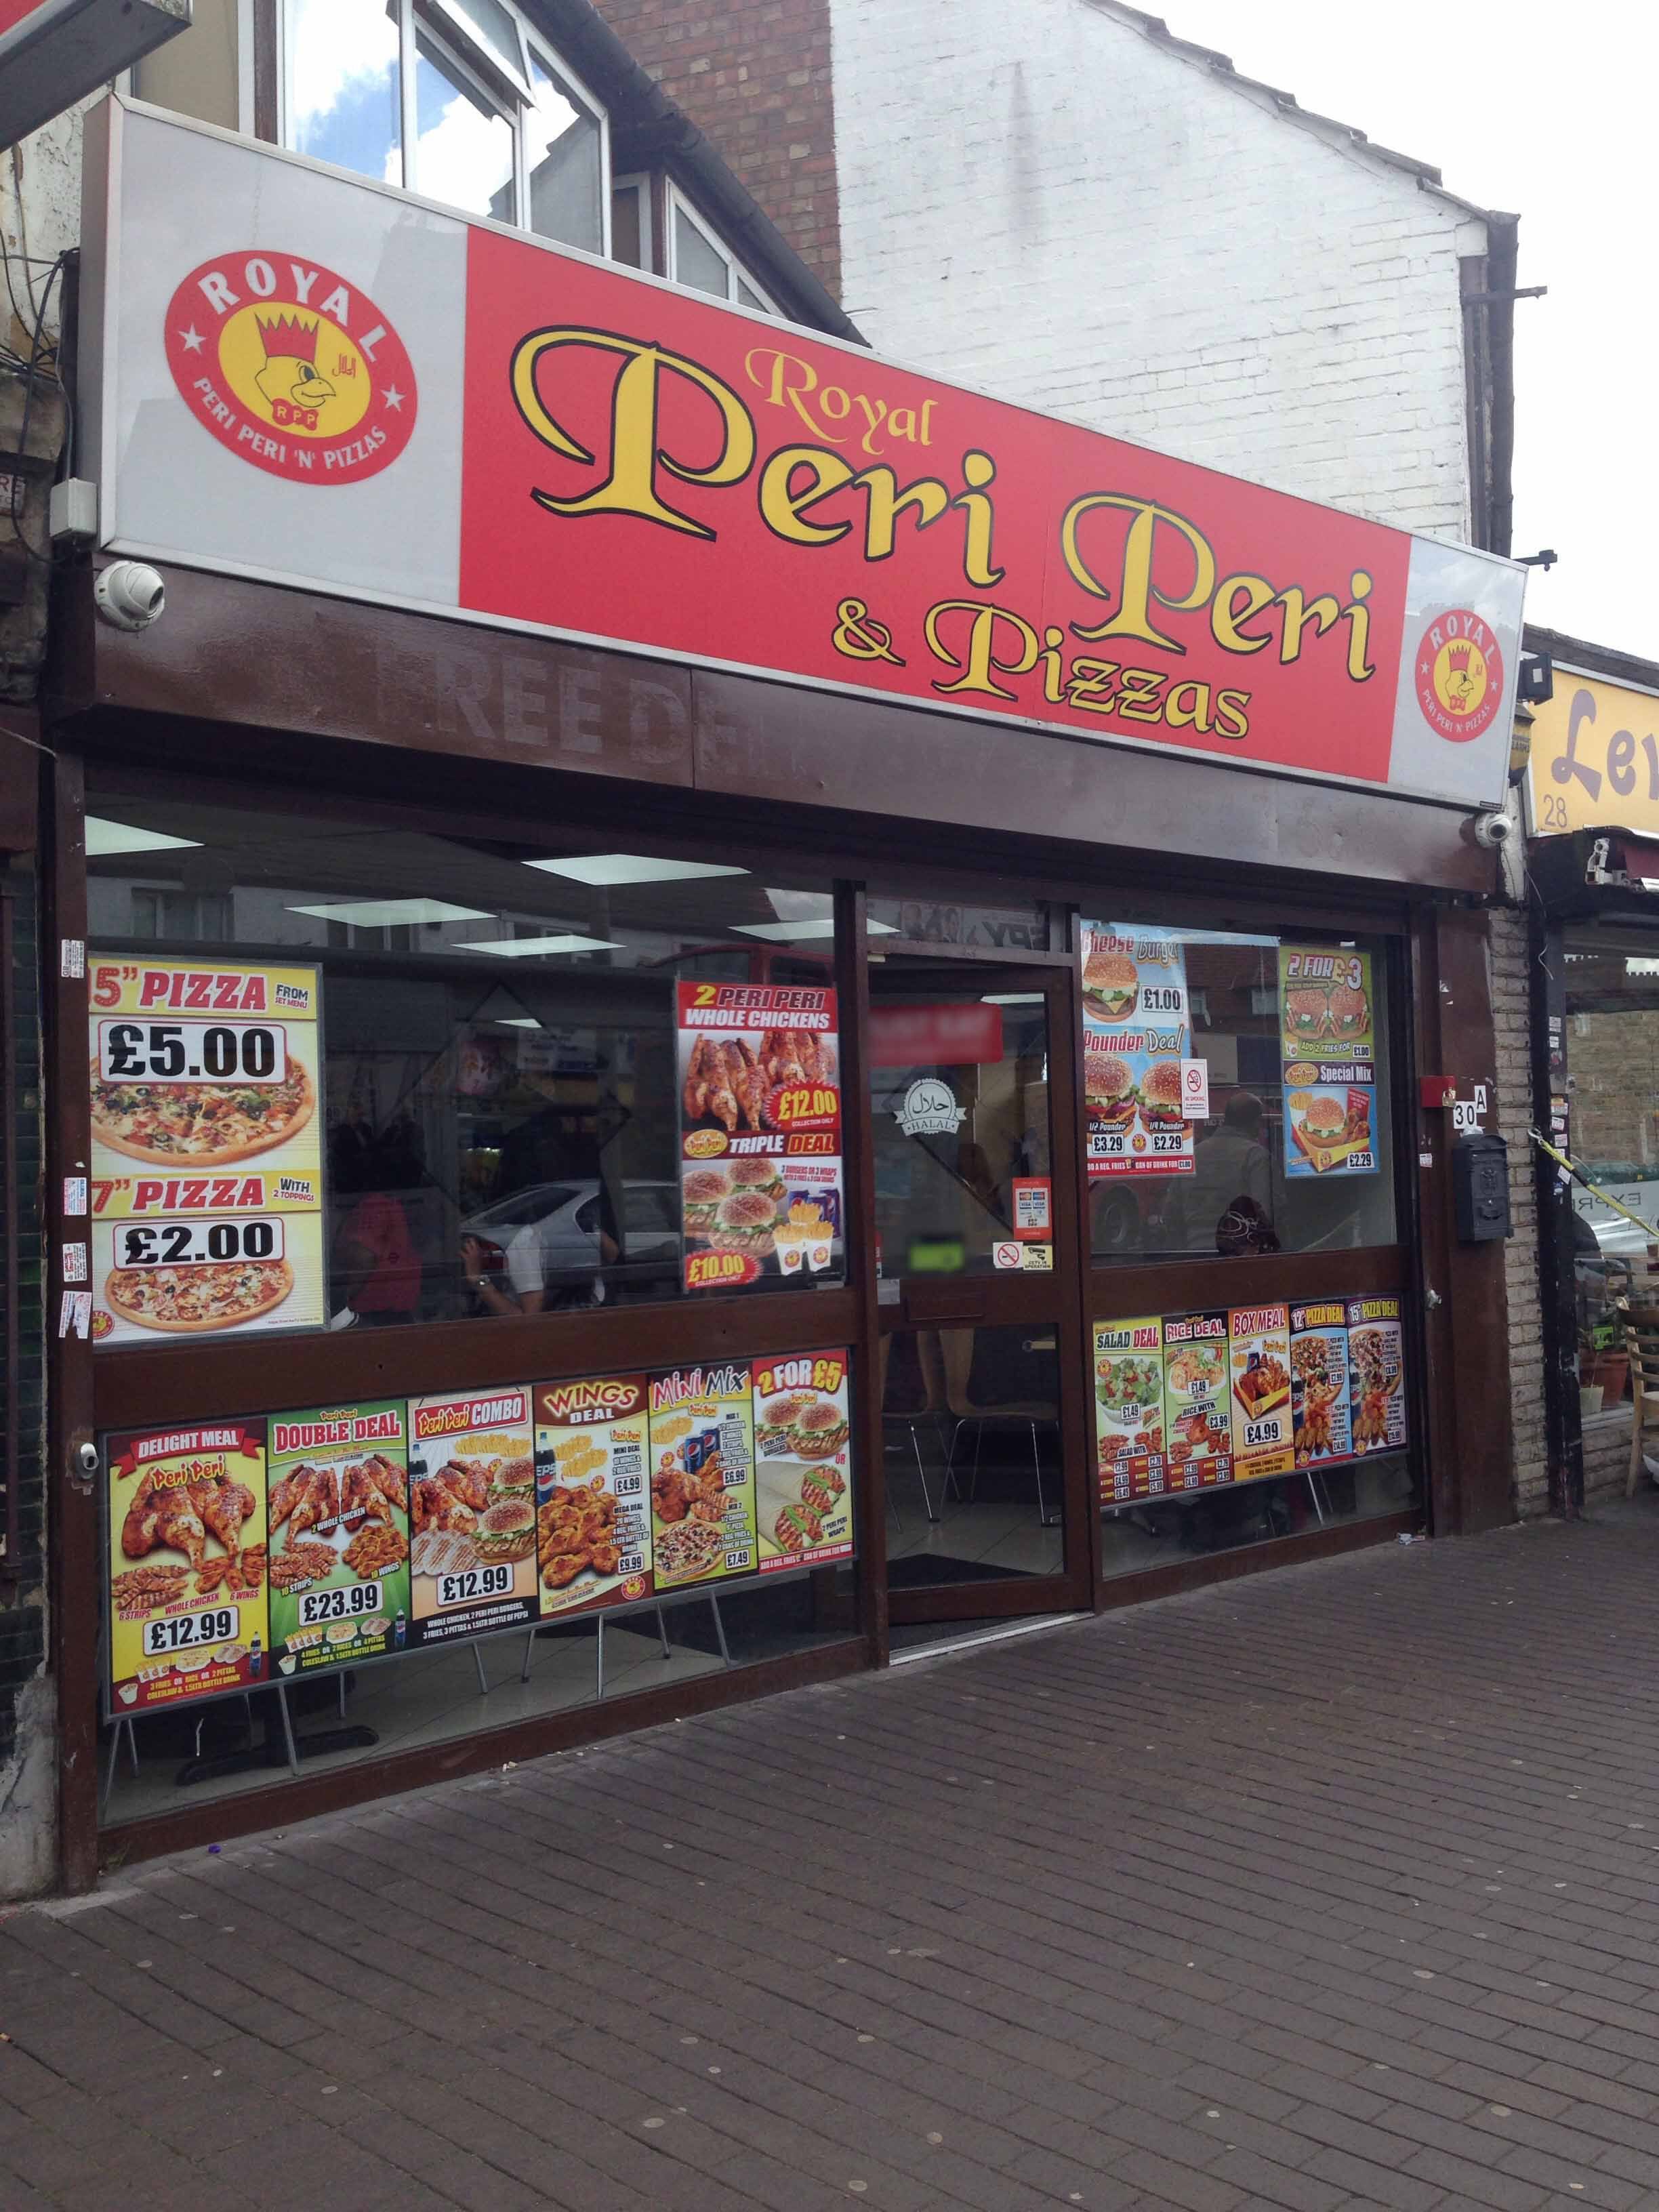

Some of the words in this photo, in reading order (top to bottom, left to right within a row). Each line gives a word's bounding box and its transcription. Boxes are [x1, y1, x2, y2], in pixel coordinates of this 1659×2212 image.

[197, 258, 386, 362] ROYAL
[745, 347, 938, 455] Royal
[193, 377, 233, 430] PERI
[237, 425, 286, 464] PERI
[324, 426, 387, 470] PIZZAS
[509, 324, 1006, 588] Peri
[1059, 491, 1376, 682] Peri
[1430, 615, 1495, 664] ROYAL
[831, 596, 906, 668] &
[924, 598, 1252, 739] Pizzas
[1423, 689, 1437, 716] PERI
[1437, 715, 1453, 733] PERI
[1466, 705, 1490, 731] PIZZAS
[1544, 794, 1567, 827] 28
[1288, 953, 1300, 976] 2
[1303, 954, 1334, 977] FOR
[140, 971, 267, 1010] PIZZA
[276, 983, 308, 1002] FROM
[693, 985, 716, 1006] 2
[717, 987, 772, 1008] PERI
[773, 989, 825, 1010] PERI
[1144, 988, 1181, 1010] £1.00
[274, 996, 287, 1006] SET
[287, 998, 308, 1008] MENU
[685, 1008, 745, 1027] WHOLE
[747, 1011, 830, 1029] CHICKENS
[1084, 1029, 1145, 1052] Pounder
[1147, 1023, 1184, 1052] Deal
[1301, 1041, 1313, 1051] ADD
[1321, 1044, 1338, 1052] FRIES
[108, 1024, 275, 1078] £5.00
[1353, 1046, 1369, 1056] £1.00
[1320, 1065, 1354, 1082] Special
[1355, 1066, 1372, 1082] Mix
[778, 1090, 837, 1120] £12.00
[912, 1092, 949, 1113] حلال
[1477, 1089, 1486, 1109] A
[912, 1119, 951, 1131] HALAL
[1455, 1105, 1475, 1125] 30
[1099, 1122, 1126, 1131] Pounder
[1160, 1122, 1185, 1130] Pounder
[730, 1135, 785, 1153] TRIPLE
[787, 1134, 834, 1153] DEAL
[1094, 1136, 1123, 1152] £3.29
[1153, 1134, 1182, 1151] £2.29
[1349, 1153, 1372, 1167] £2.29
[133, 1178, 263, 1211] PIZZA
[280, 1177, 310, 1193] WITH
[273, 1189, 279, 1197] 2
[281, 1191, 314, 1202] TOPPINGS
[125, 1222, 273, 1265] £2.00
[688, 1254, 745, 1283] £10.00
[695, 1277, 727, 1287] COLLECTION
[1305, 1306, 1326, 1326] PIZZA
[1326, 1304, 1345, 1325] DEAL
[1362, 1300, 1381, 1319] PIZZA
[1381, 1299, 1399, 1317] DEAL
[1166, 1322, 1193, 1343] RICE
[1194, 1319, 1227, 1338] DEAL
[1233, 1313, 1256, 1338] BOX
[1256, 1308, 1286, 1333] MEAL
[1097, 1330, 1131, 1349] SALAD
[1132, 1326, 1160, 1348] DEAL
[758, 1371, 775, 1395] 2
[773, 1359, 813, 1389] FOR
[813, 1359, 842, 1392] £5
[1191, 1380, 1206, 1394] £1.49
[544, 1381, 640, 1418] WINGS
[1182, 1406, 1197, 1417] RICE
[1197, 1401, 1216, 1412] WITH
[418, 1409, 445, 1435] Peri
[444, 1404, 470, 1431] Peri
[471, 1397, 523, 1425] COMBO
[569, 1408, 615, 1424] DEAL
[1122, 1405, 1139, 1419] £1.49
[1210, 1414, 1229, 1429] £3.99
[274, 1420, 351, 1453] DOUBLE
[353, 1410, 401, 1441] DEAL
[1246, 1422, 1279, 1443] £4.99
[138, 1432, 199, 1458] DELIGHT
[201, 1430, 239, 1446] MEAL
[613, 1446, 627, 1454] MINI
[628, 1445, 640, 1453] DEAL
[1118, 1447, 1133, 1457] SALAD
[1134, 1445, 1146, 1454] WITH
[835, 1453, 846, 1465] OR
[152, 1462, 188, 1490] Peri
[189, 1453, 226, 1482] Peri
[724, 1468, 745, 1483] £6.99
[617, 1477, 640, 1492] £4.99
[311, 1524, 316, 1534] 2
[316, 1516, 339, 1532] WHOLE
[339, 1507, 365, 1523] CHICKEN
[825, 1520, 837, 1530] PERI
[828, 1527, 846, 1538] WRAPS
[379, 1561, 400, 1577] WINGS
[619, 1555, 642, 1572] £9.99
[727, 1551, 747, 1566] £7.49
[289, 1578, 312, 1593] STRIPS
[443, 1566, 508, 1601] £12.99
[165, 1600, 189, 1615] WHOLE
[190, 1593, 219, 1609] CHICKEN
[230, 1593, 236, 1601] 6
[237, 1590, 259, 1600] WINGS
[304, 1584, 377, 1622] £23.99
[119, 1612, 125, 1621] 6
[126, 1608, 151, 1620] STRIPS
[423, 1631, 427, 1639] 3
[448, 1623, 467, 1634] PITTAS
[488, 1616, 506, 1626] BOTTLE
[514, 1610, 529, 1620] PEPSI
[427, 1618, 446, 1628] WHOLE
[475, 1610, 487, 1618] PERI
[487, 1607, 499, 1616] PERI
[151, 1610, 231, 1650] £12.99
